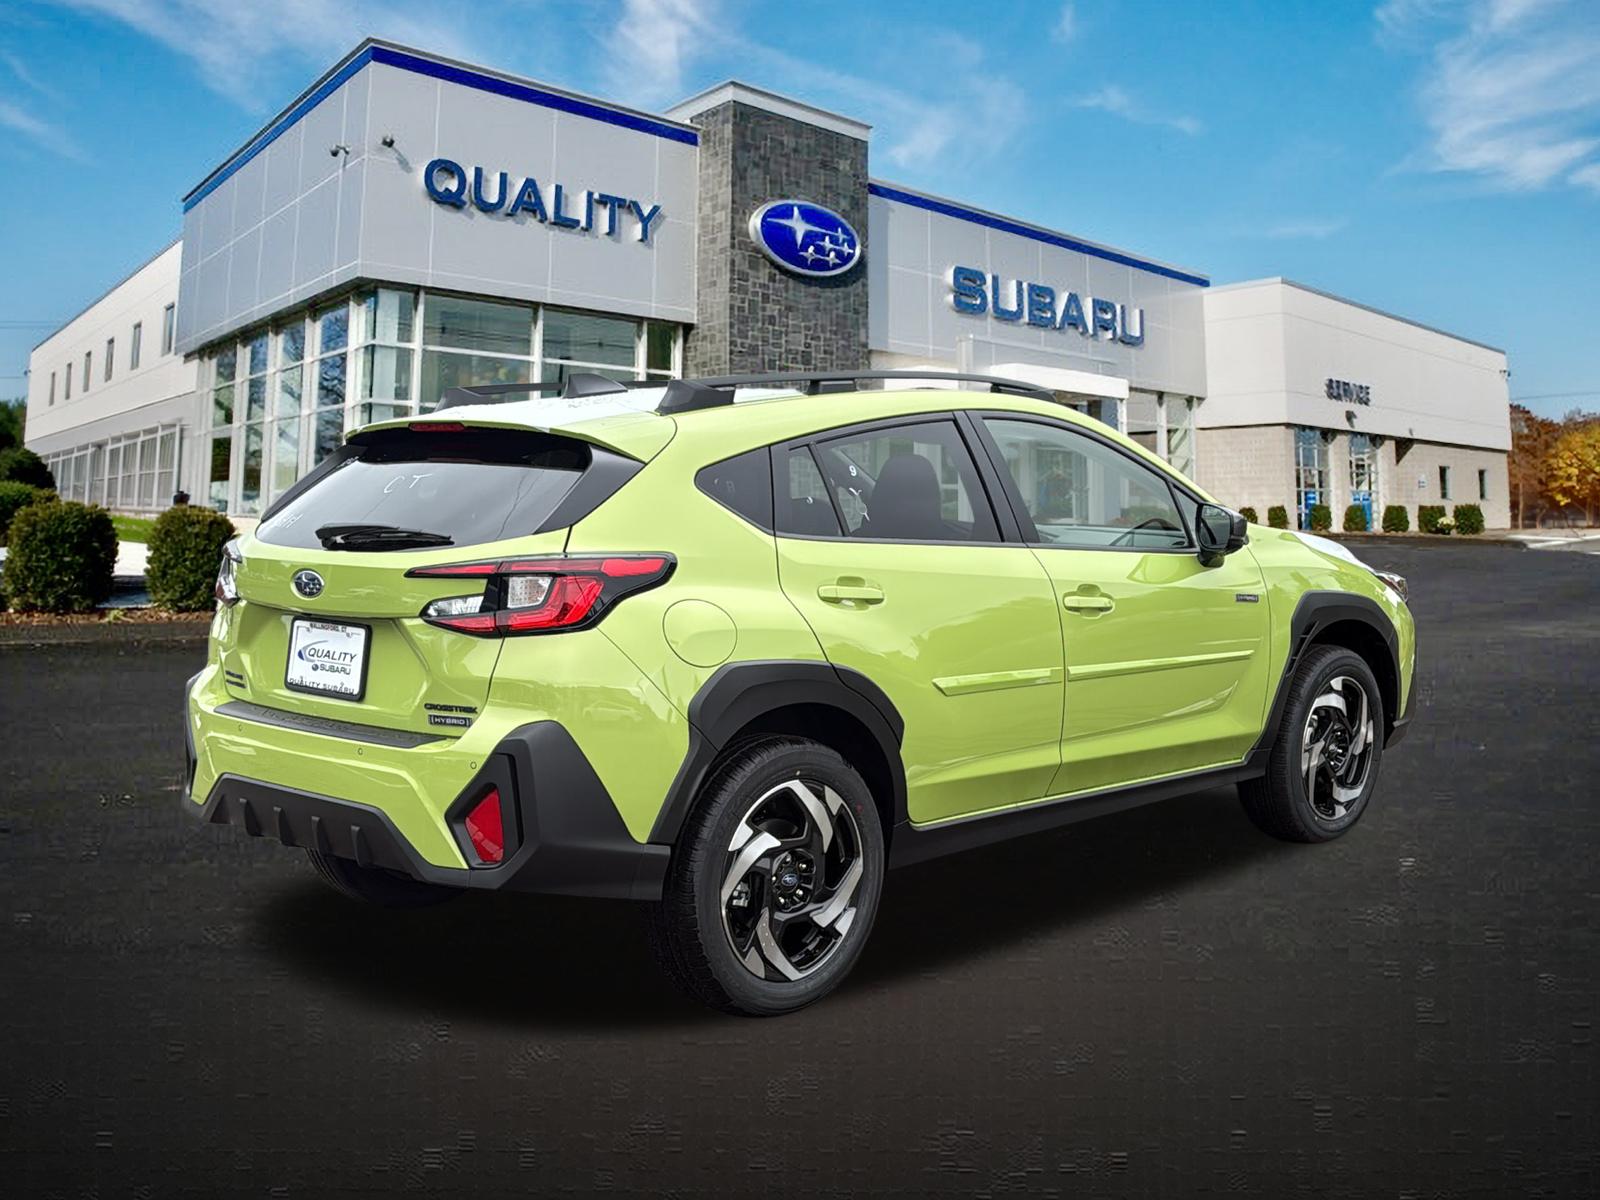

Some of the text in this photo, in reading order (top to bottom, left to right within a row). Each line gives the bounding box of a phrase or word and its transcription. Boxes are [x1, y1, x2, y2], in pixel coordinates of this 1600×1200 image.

[423, 157, 661, 243] QUALITY
[950, 265, 1145, 347] SUBARU
[307, 647, 357, 663] QUALITY
[319, 663, 351, 676] SUBARU
